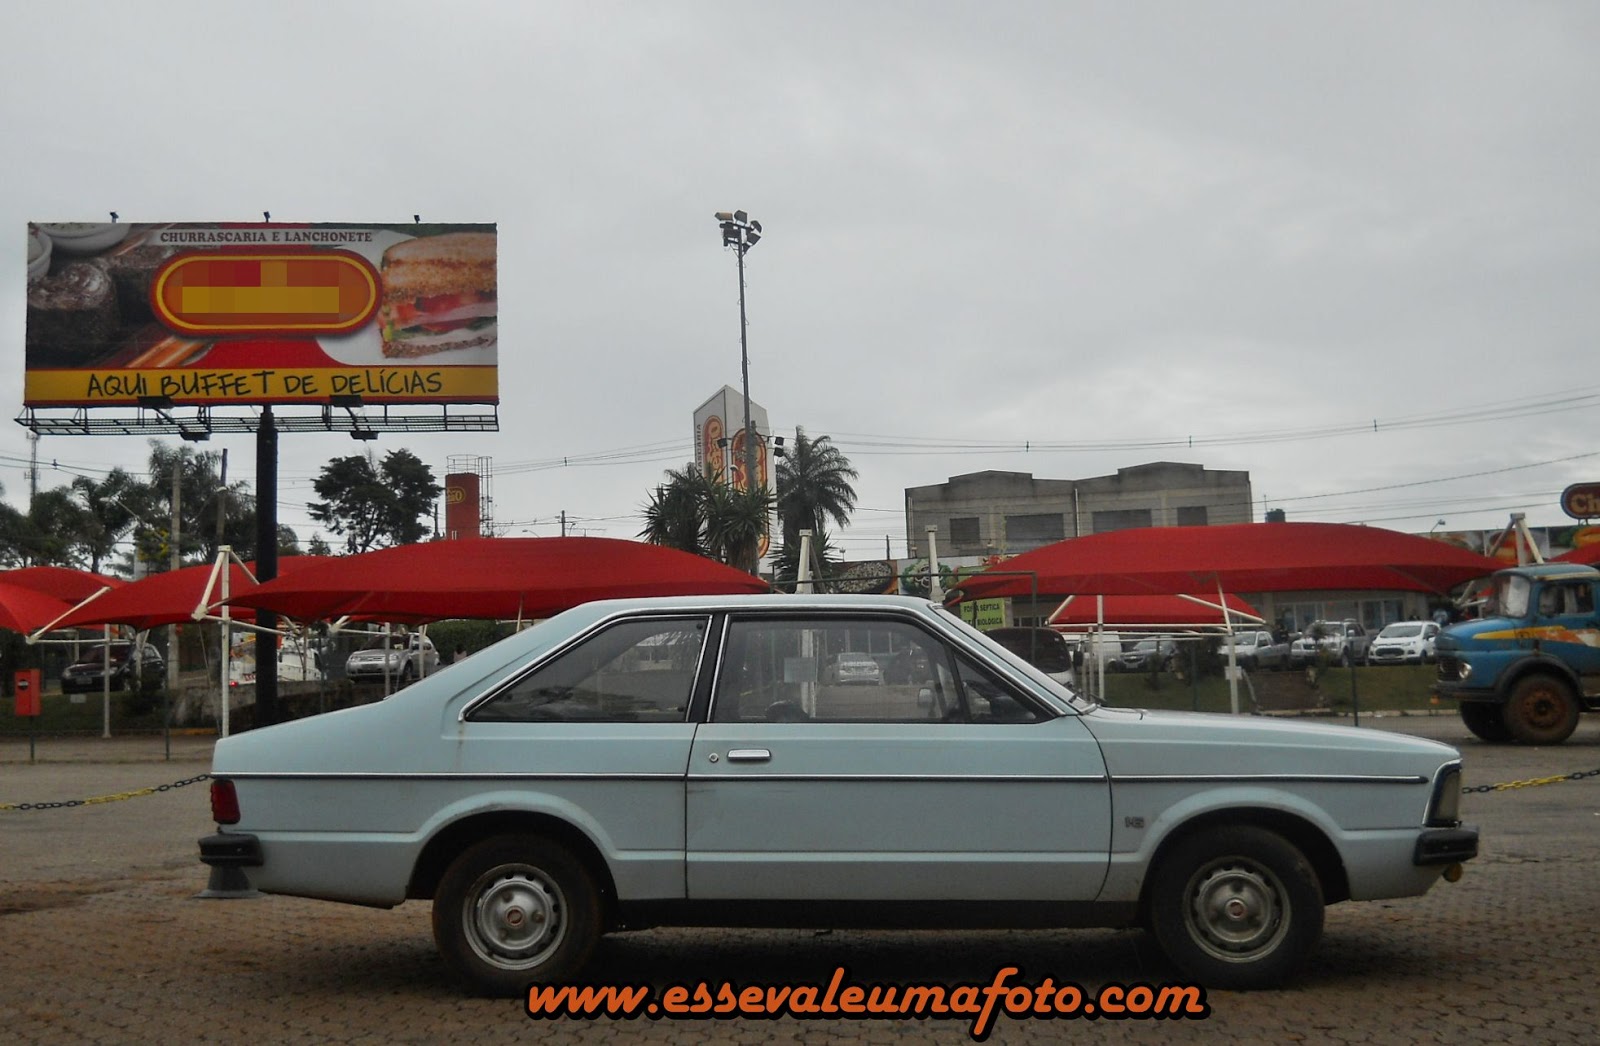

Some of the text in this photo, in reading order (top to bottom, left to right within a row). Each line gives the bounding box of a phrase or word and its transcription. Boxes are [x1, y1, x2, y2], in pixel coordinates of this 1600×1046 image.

[160, 231, 373, 243] CHURRASCARIA E LANCHONETE
[87, 369, 443, 398] AQUI BUFFET DE DELÍCIAS
